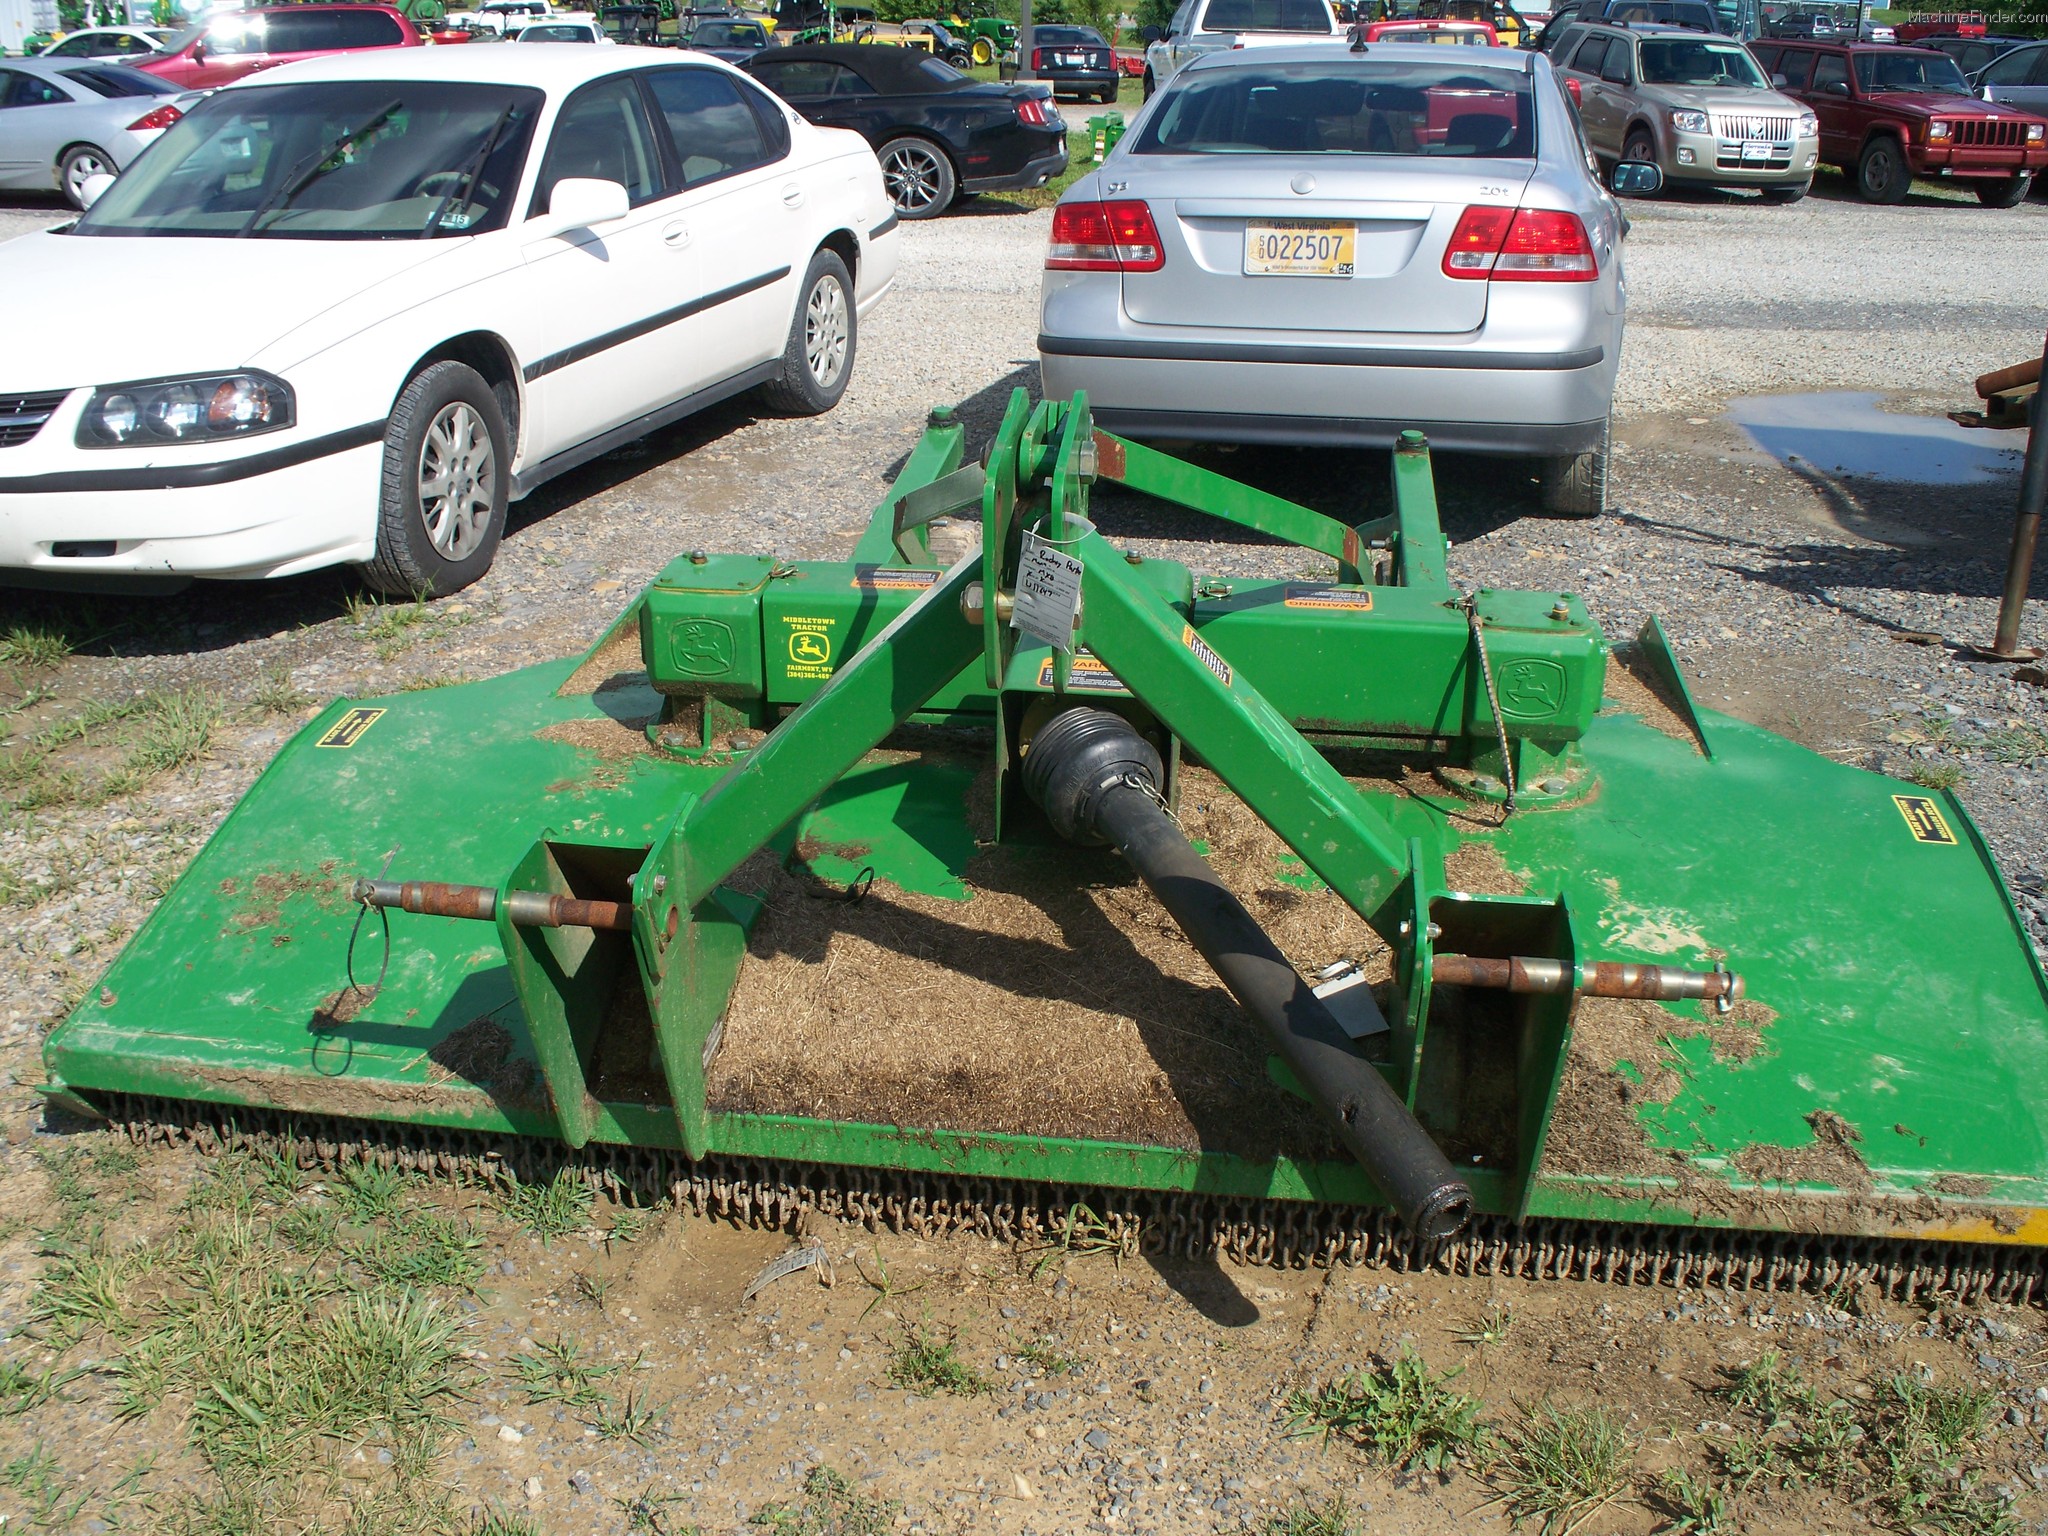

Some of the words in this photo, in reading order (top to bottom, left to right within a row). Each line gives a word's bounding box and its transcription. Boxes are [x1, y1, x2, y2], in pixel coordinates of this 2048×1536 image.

[1274, 221, 1295, 230] West
[1297, 221, 1331, 233] Virginia
[1267, 235, 1343, 261] 022507
[783, 616, 836, 625] MIDDLETOWN
